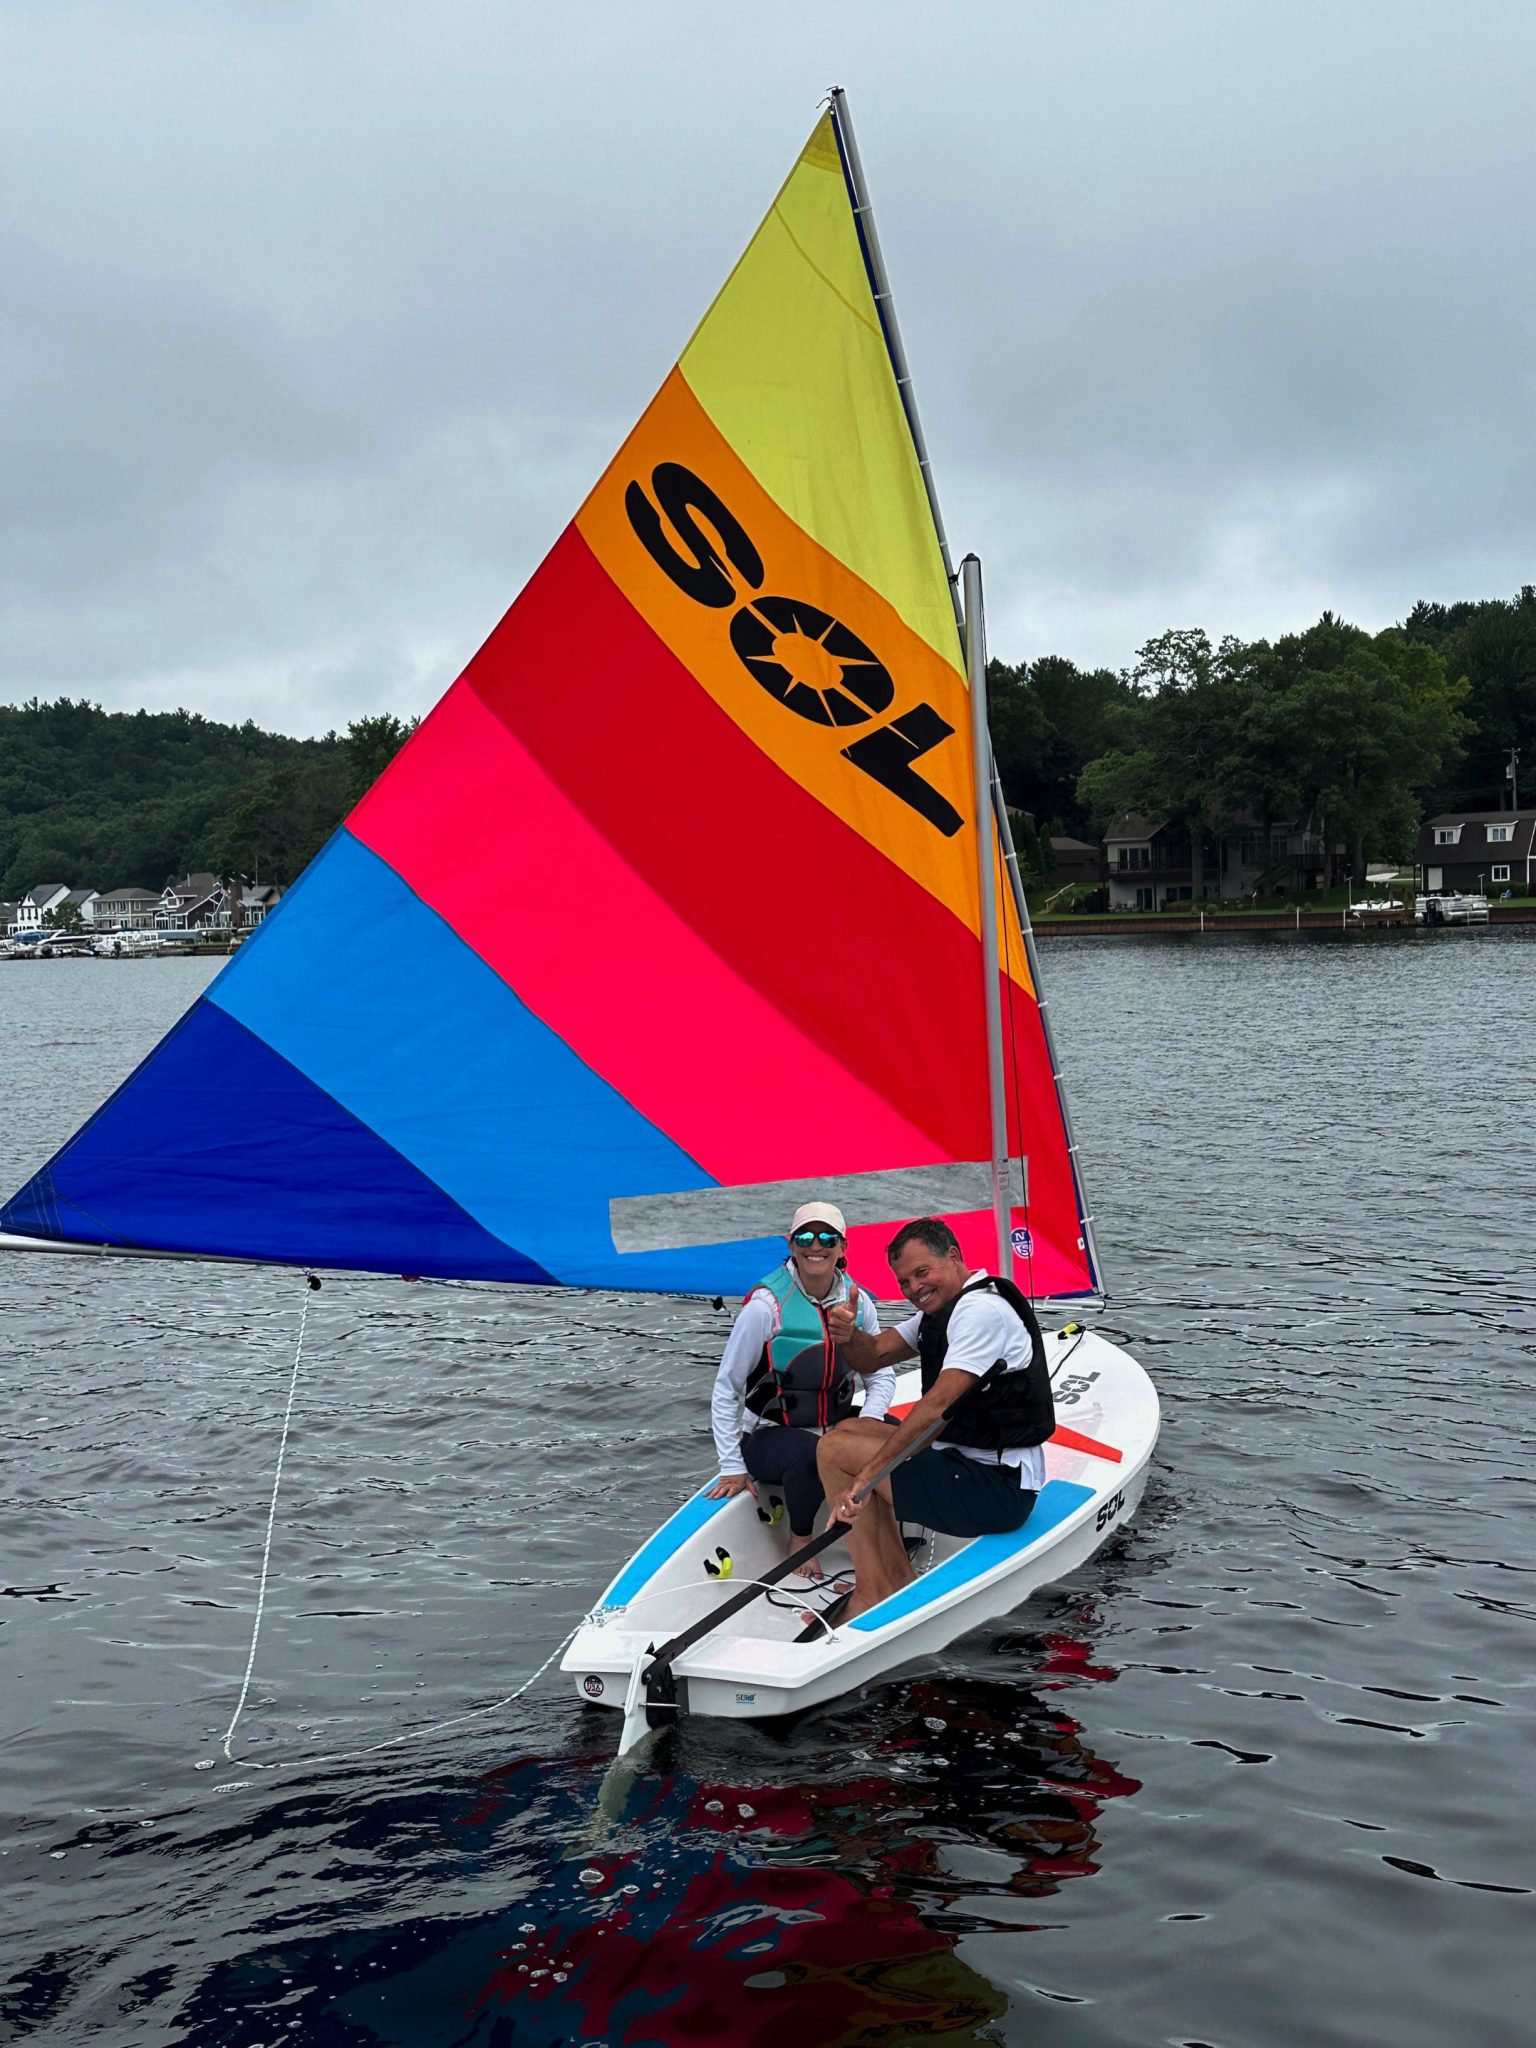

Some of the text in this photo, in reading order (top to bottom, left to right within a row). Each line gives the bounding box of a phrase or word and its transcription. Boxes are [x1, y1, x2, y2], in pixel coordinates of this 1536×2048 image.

[624, 461, 965, 838] SOL
[1015, 1232, 1025, 1241] N
[1053, 1371, 1102, 1405] SOL
[1095, 1488, 1126, 1533] SOL
